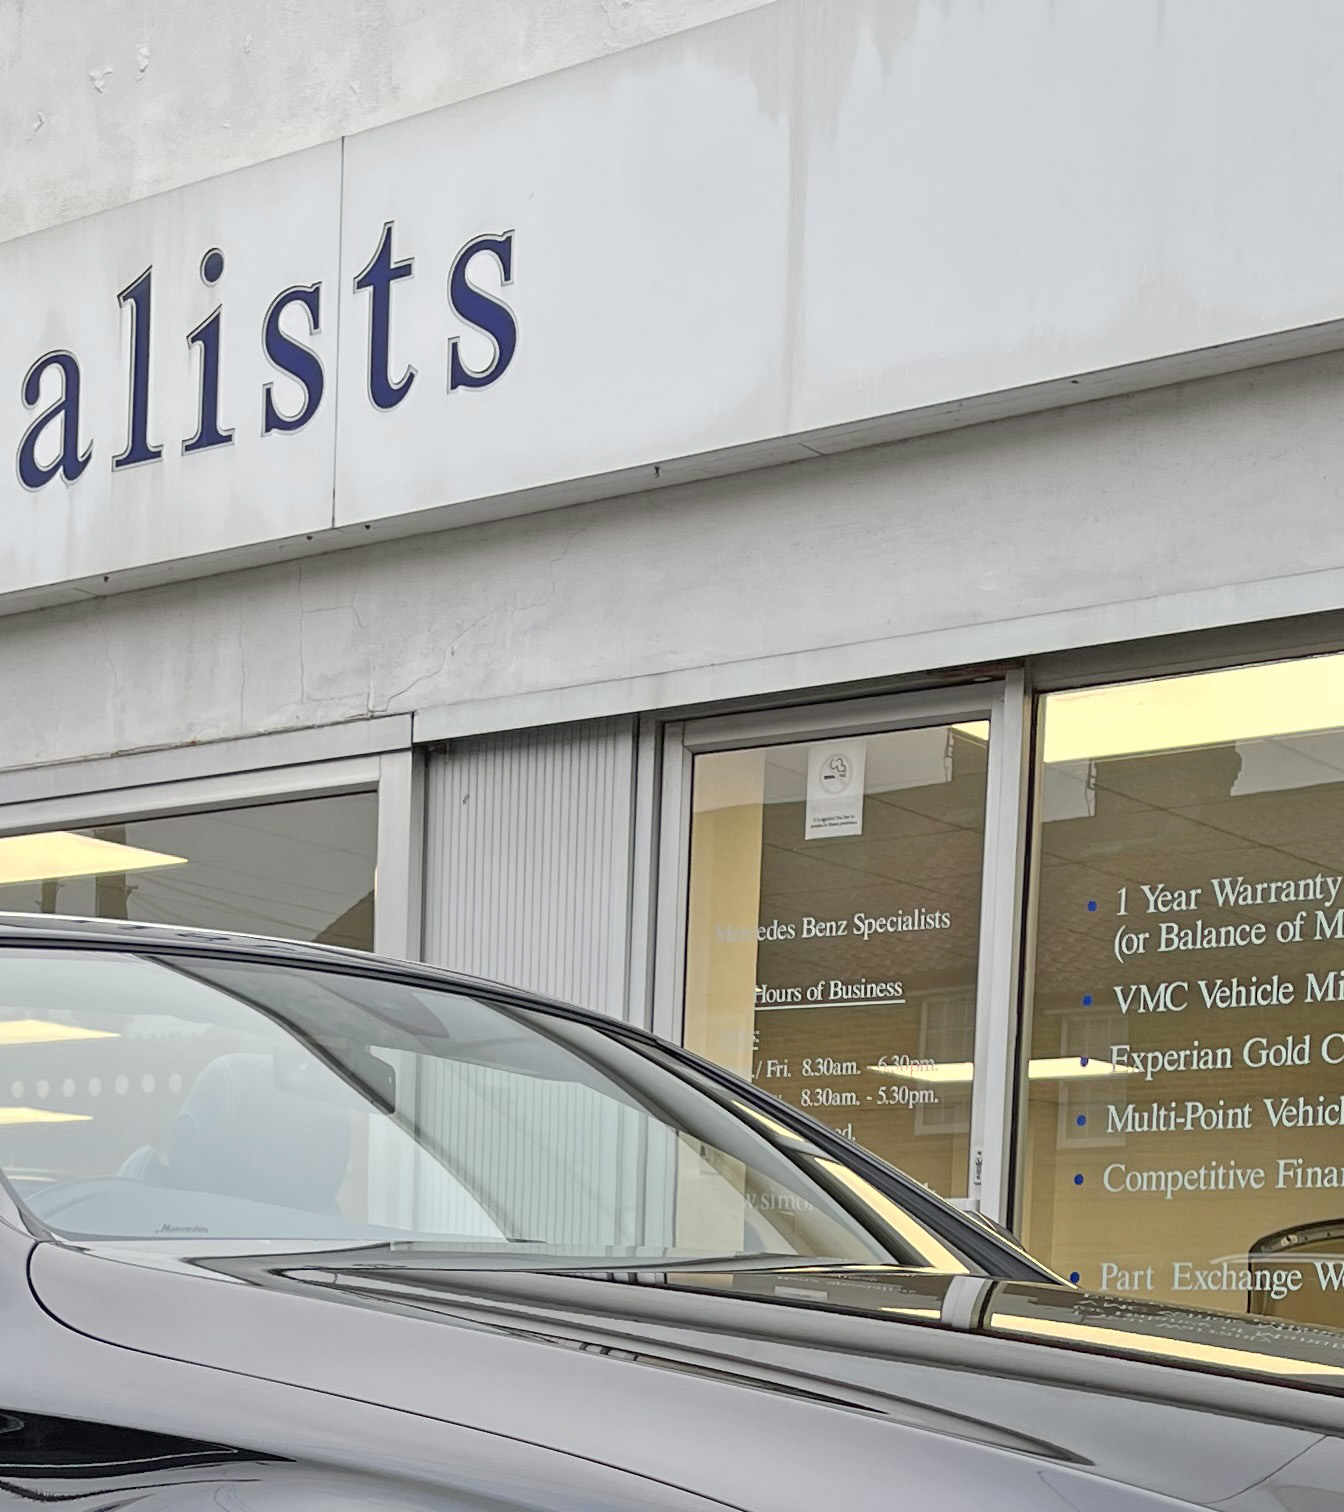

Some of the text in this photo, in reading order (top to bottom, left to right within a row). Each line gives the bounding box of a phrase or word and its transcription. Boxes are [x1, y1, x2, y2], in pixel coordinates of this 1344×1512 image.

[1116, 873, 1343, 916] 1 Year Warranty
[801, 917, 848, 939] Benz
[852, 907, 951, 940] Specialists
[1114, 925, 1150, 963] (or
[1158, 919, 1267, 952] Balance
[1276, 911, 1307, 943] of
[755, 978, 903, 1005] Hours of Business
[1113, 981, 1189, 1015] VMC
[1197, 975, 1295, 1010] Vehicle
[766, 1059, 792, 1078] Fri.
[801, 1057, 861, 1077] 8.30am.
[1109, 1041, 1233, 1081] Experian
[1243, 1034, 1311, 1068] Gold
[801, 1087, 860, 1107] 8.30am.
[876, 1085, 939, 1109] 5.30pm.
[1106, 1099, 1253, 1134] Multi-Point
[1102, 1161, 1265, 1199] Competitive
[1100, 1262, 1155, 1292] Part
[1171, 1261, 1303, 1300] Exchange
